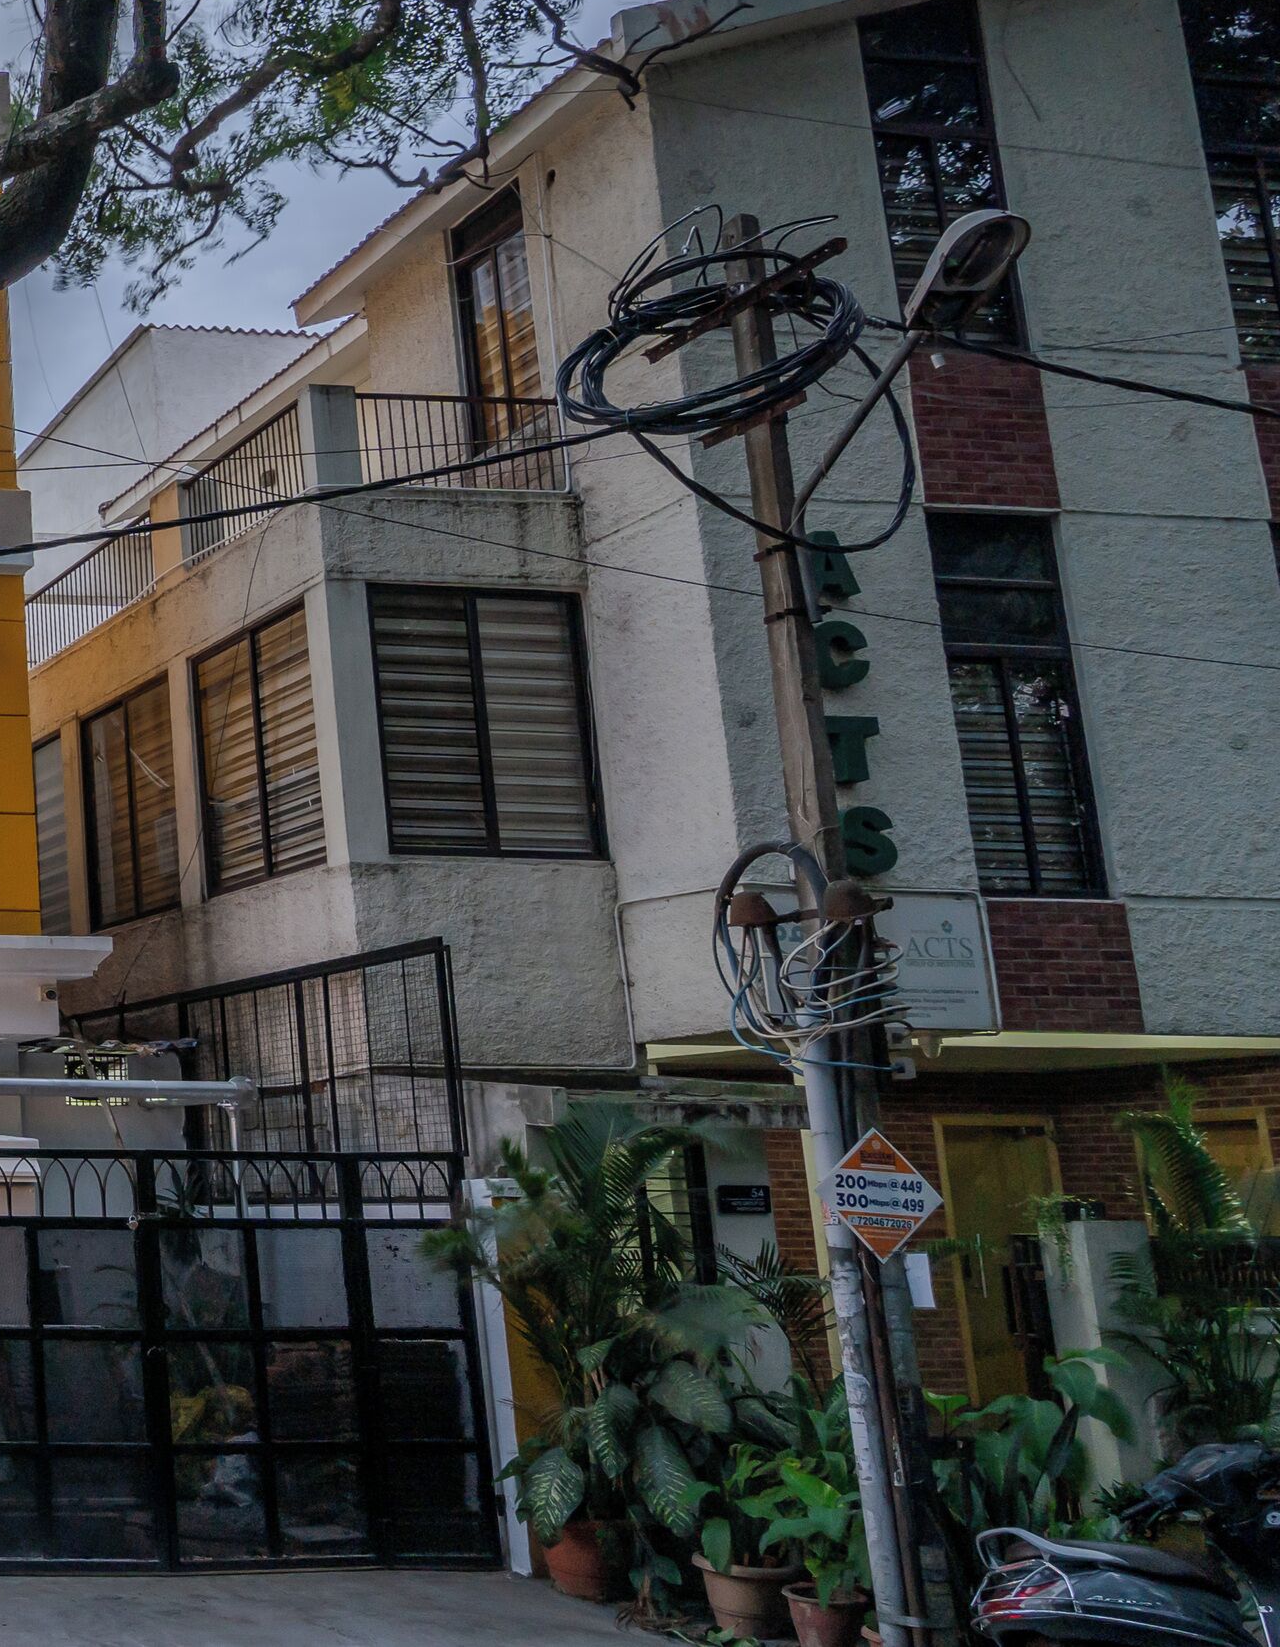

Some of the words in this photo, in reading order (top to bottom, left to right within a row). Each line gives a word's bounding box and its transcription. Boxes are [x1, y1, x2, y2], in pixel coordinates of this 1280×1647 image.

[803, 529, 899, 879] ACTS
[906, 935, 974, 959] ACTS
[751, 1187, 764, 1198] 54
[857, 1216, 913, 1229] 7204672026
